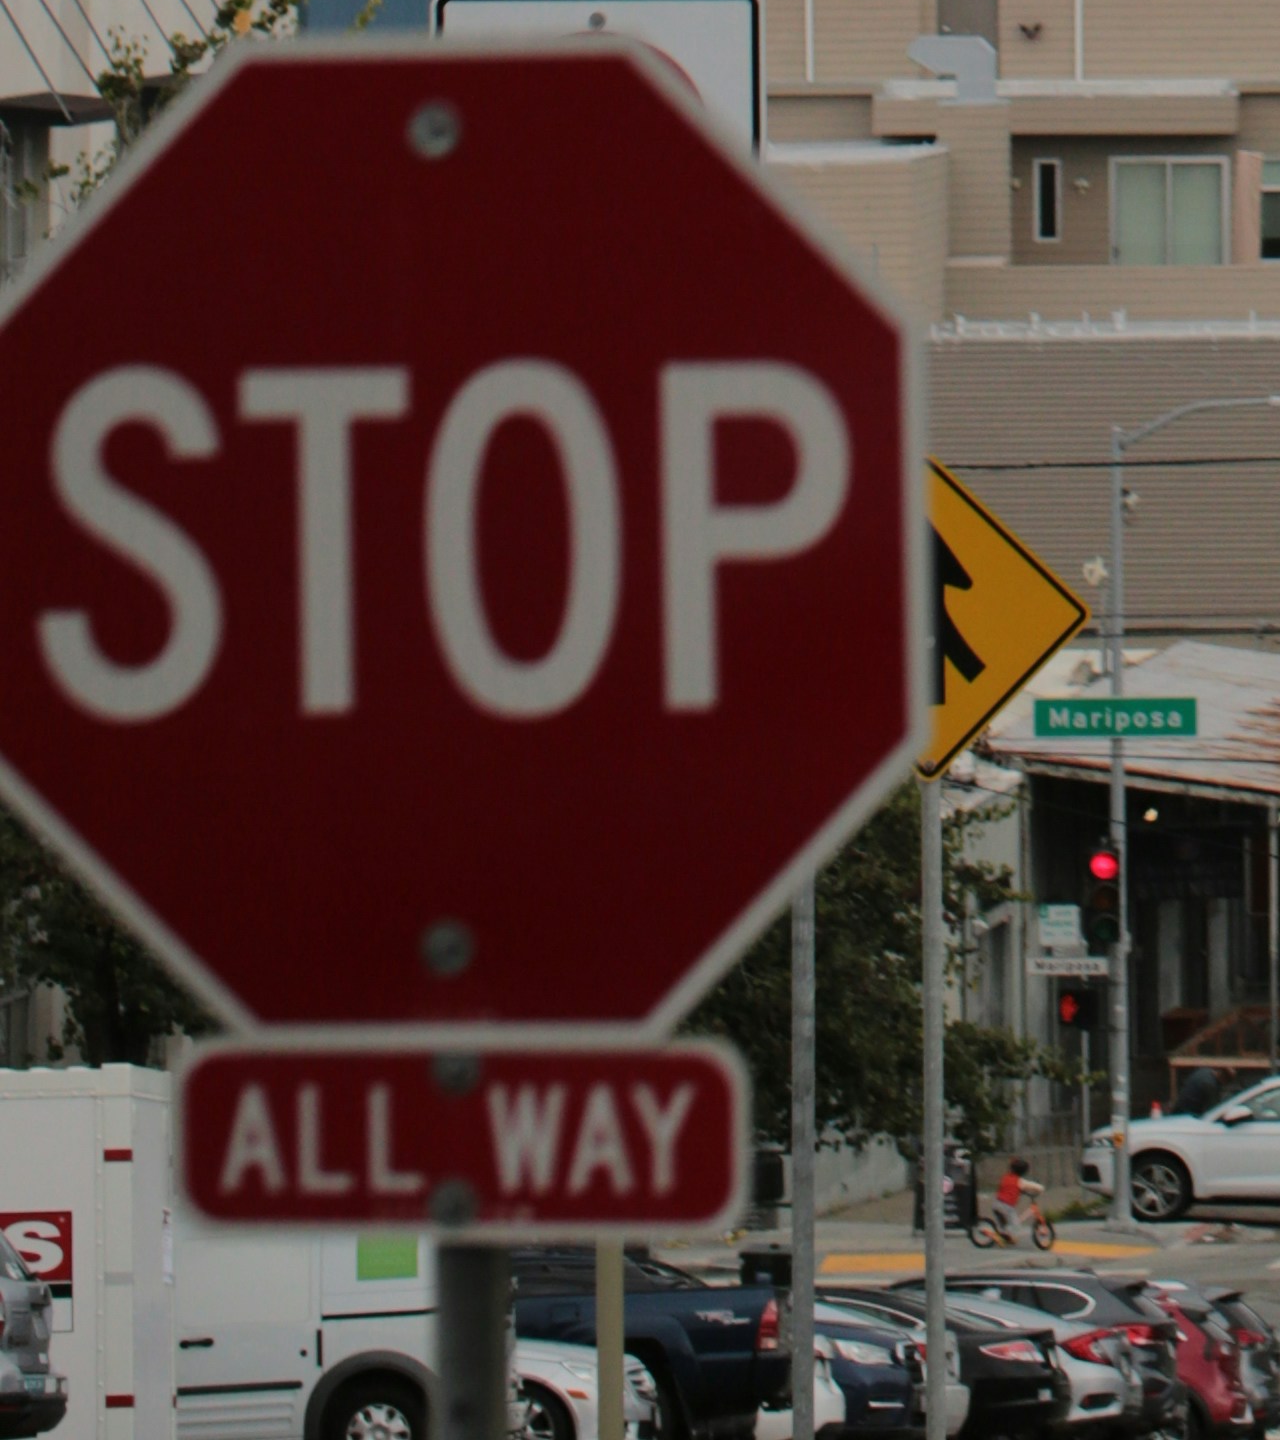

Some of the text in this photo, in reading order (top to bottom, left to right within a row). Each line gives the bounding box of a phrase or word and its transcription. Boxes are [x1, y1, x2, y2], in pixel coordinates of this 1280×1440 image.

[36, 357, 851, 721] STOP
[1048, 706, 1183, 731] Mariposa
[219, 1083, 695, 1196] ALL WAY
